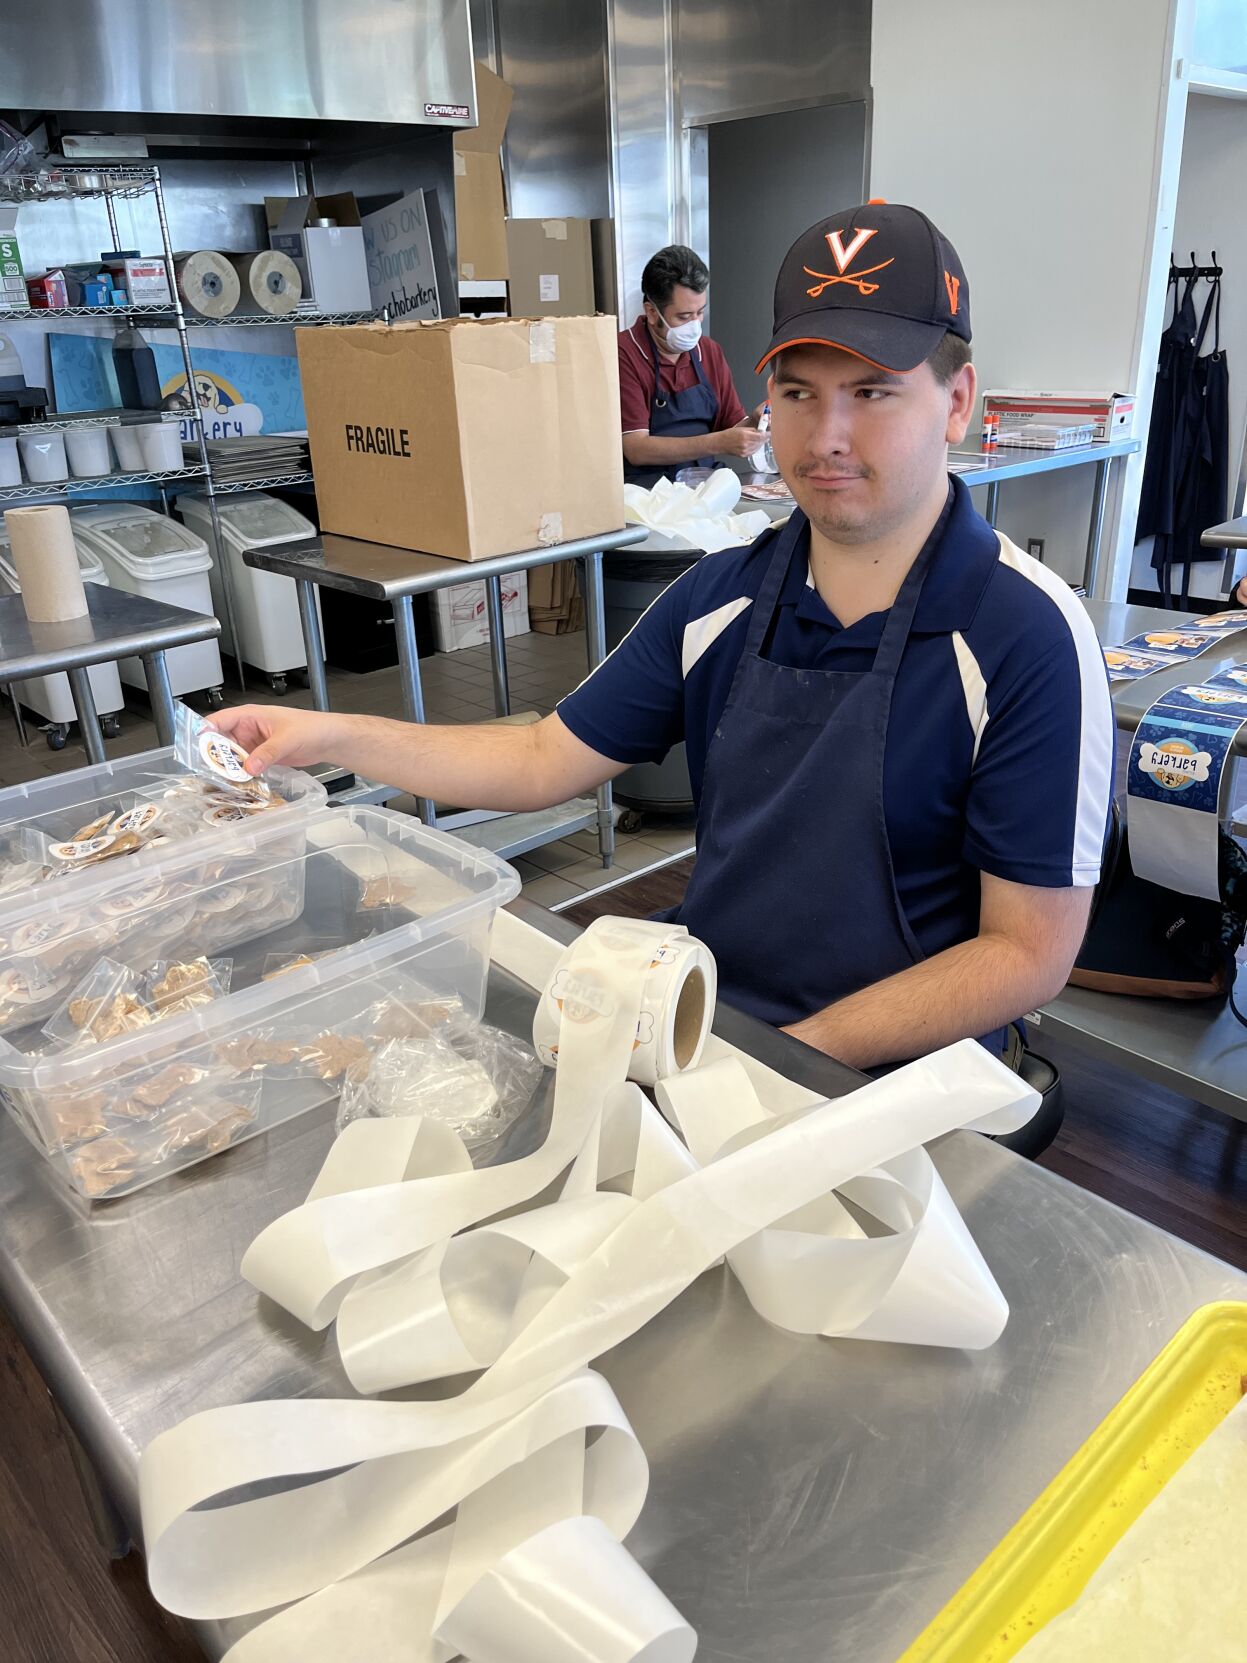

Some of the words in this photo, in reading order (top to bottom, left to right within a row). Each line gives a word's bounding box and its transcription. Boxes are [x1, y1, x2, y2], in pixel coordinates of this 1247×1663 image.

[401, 202, 422, 233] ON
[825, 228, 879, 275] V
[345, 424, 411, 457] FRAGILE
[1150, 751, 1197, 772] barkery
